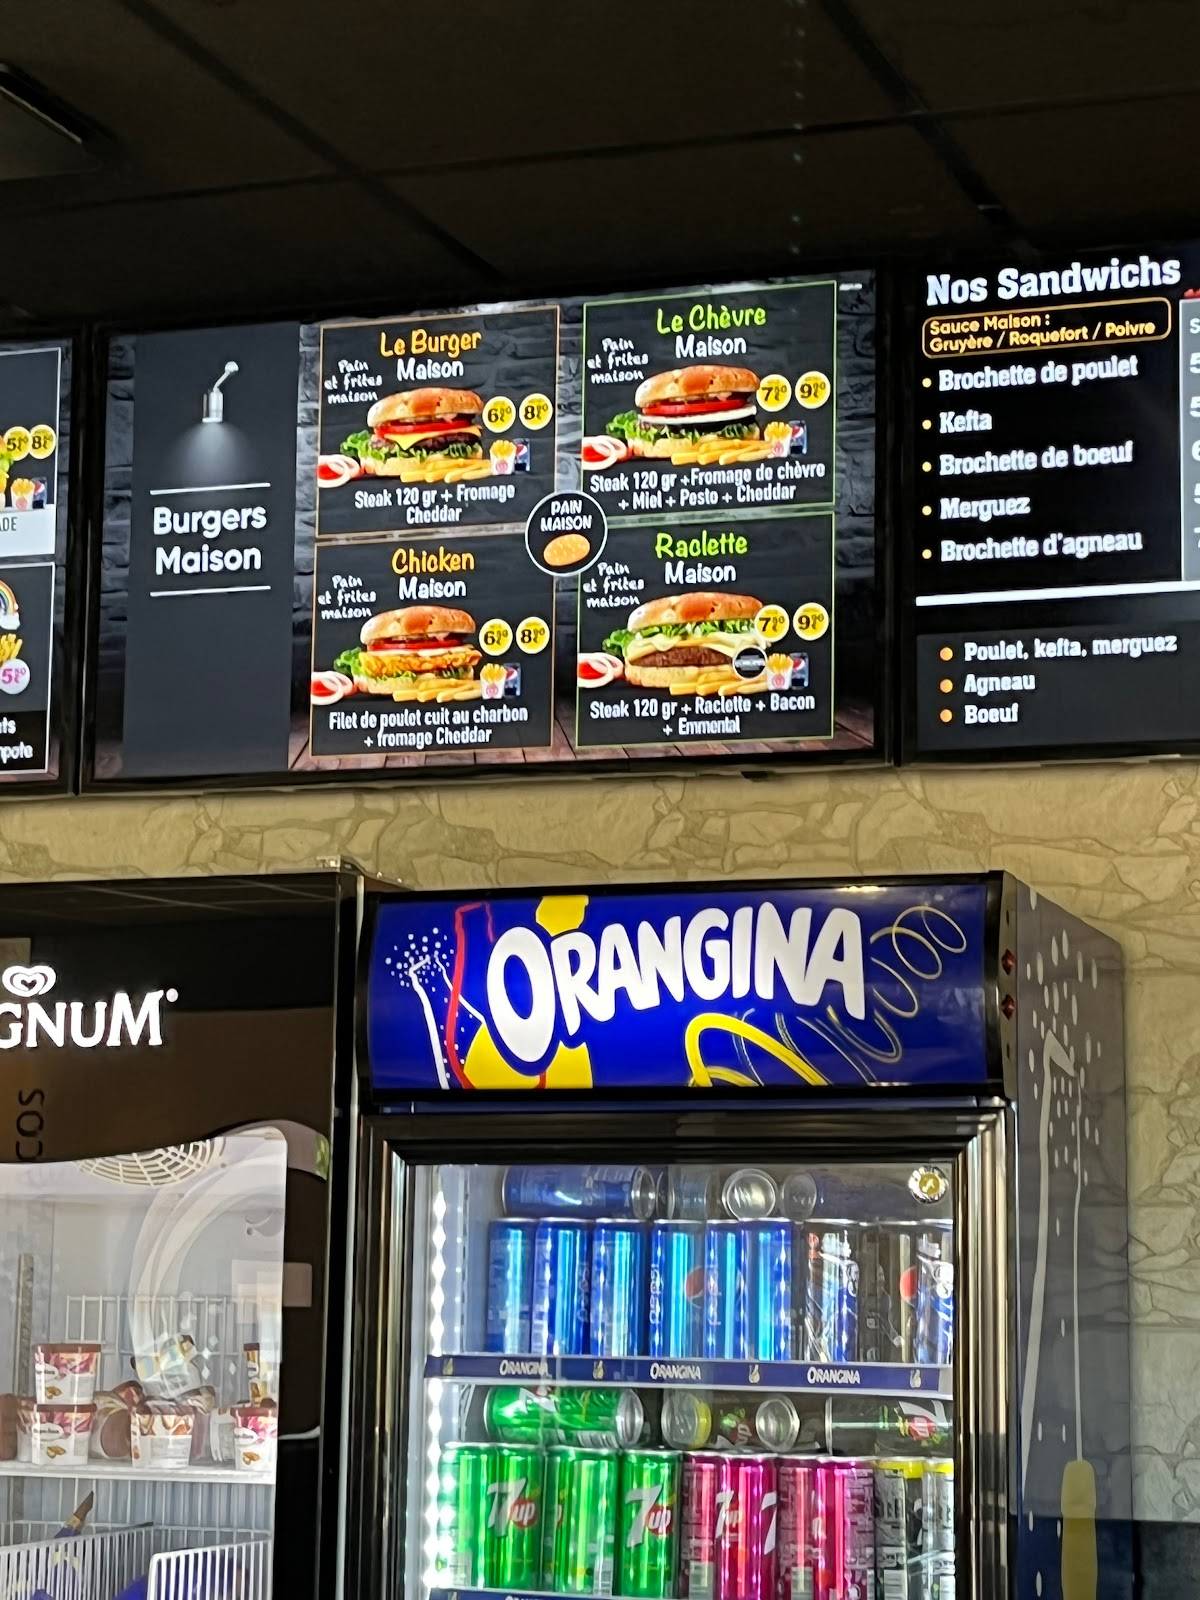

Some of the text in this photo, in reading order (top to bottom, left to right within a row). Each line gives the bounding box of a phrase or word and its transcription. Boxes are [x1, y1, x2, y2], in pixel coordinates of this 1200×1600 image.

[926, 255, 1181, 306] Nos Sandwichs
[656, 304, 766, 334] Le Chèvre
[930, 320, 980, 336] Sauce
[983, 314, 1042, 331] Maison
[380, 328, 482, 358] Le Burger
[602, 337, 634, 352] Pain
[675, 334, 747, 358] Maison
[930, 333, 993, 353] Gruyère
[1009, 326, 1088, 347] Roquefort
[1105, 321, 1156, 338] Poivre
[338, 360, 369, 373] Pain
[397, 358, 463, 381] Maison
[587, 352, 649, 370] et frites
[324, 374, 383, 391] et frites
[591, 370, 644, 384] maison
[939, 355, 1138, 391] Brochette de poulet
[328, 391, 378, 404] maison
[939, 409, 992, 434] Kefta
[939, 440, 1133, 475] Brochette de boeuf
[590, 473, 629, 493] Steak
[633, 471, 657, 490] 120
[661, 472, 677, 491] gr
[756, 463, 773, 482] de
[777, 462, 825, 480] chèvre
[354, 489, 392, 509] Steak
[395, 487, 417, 505] 120
[422, 488, 437, 506] gr
[456, 484, 515, 503] Fromage
[550, 499, 582, 516] PAIN
[633, 490, 663, 511] Miel
[680, 488, 718, 507] Pesto
[736, 482, 796, 502] Cheddar
[407, 505, 462, 524] Cheddar
[940, 497, 1031, 522] Merguez
[0, 516, 17, 531] DE
[153, 506, 267, 538] Burgers
[540, 514, 592, 532] MAISON
[655, 530, 747, 559] Raclette
[941, 532, 1143, 562] Brochette d'agneau
[155, 544, 261, 575] Maison
[392, 546, 475, 574] Chicken
[597, 562, 629, 576] Pain
[332, 575, 362, 589] Pain
[583, 576, 644, 593] et frites
[665, 561, 736, 585] Maison
[318, 590, 376, 607] et frites
[399, 576, 466, 600] Maison
[586, 595, 640, 608] maison
[321, 607, 372, 620] maison
[964, 636, 1177, 662] Poulet, kefta, merguez
[964, 674, 1035, 696] Agneau
[590, 699, 629, 719] Steak
[633, 698, 658, 717] 120
[662, 699, 678, 718] gr
[695, 695, 751, 714] Raclette
[771, 693, 815, 711] Bacon
[964, 703, 1019, 724] Boeuf
[329, 703, 528, 734] Filet de poulet cuit au charbon
[678, 716, 740, 735] Emmental
[377, 730, 432, 750] fromage
[436, 726, 492, 746] Cheddar
[0, 741, 33, 764] pote
[486, 901, 867, 1064] ORANGINA
[499, 1359, 549, 1376] ORANGINA
[650, 1362, 702, 1380] ORANGINA
[807, 1367, 861, 1384] ORANGINA
